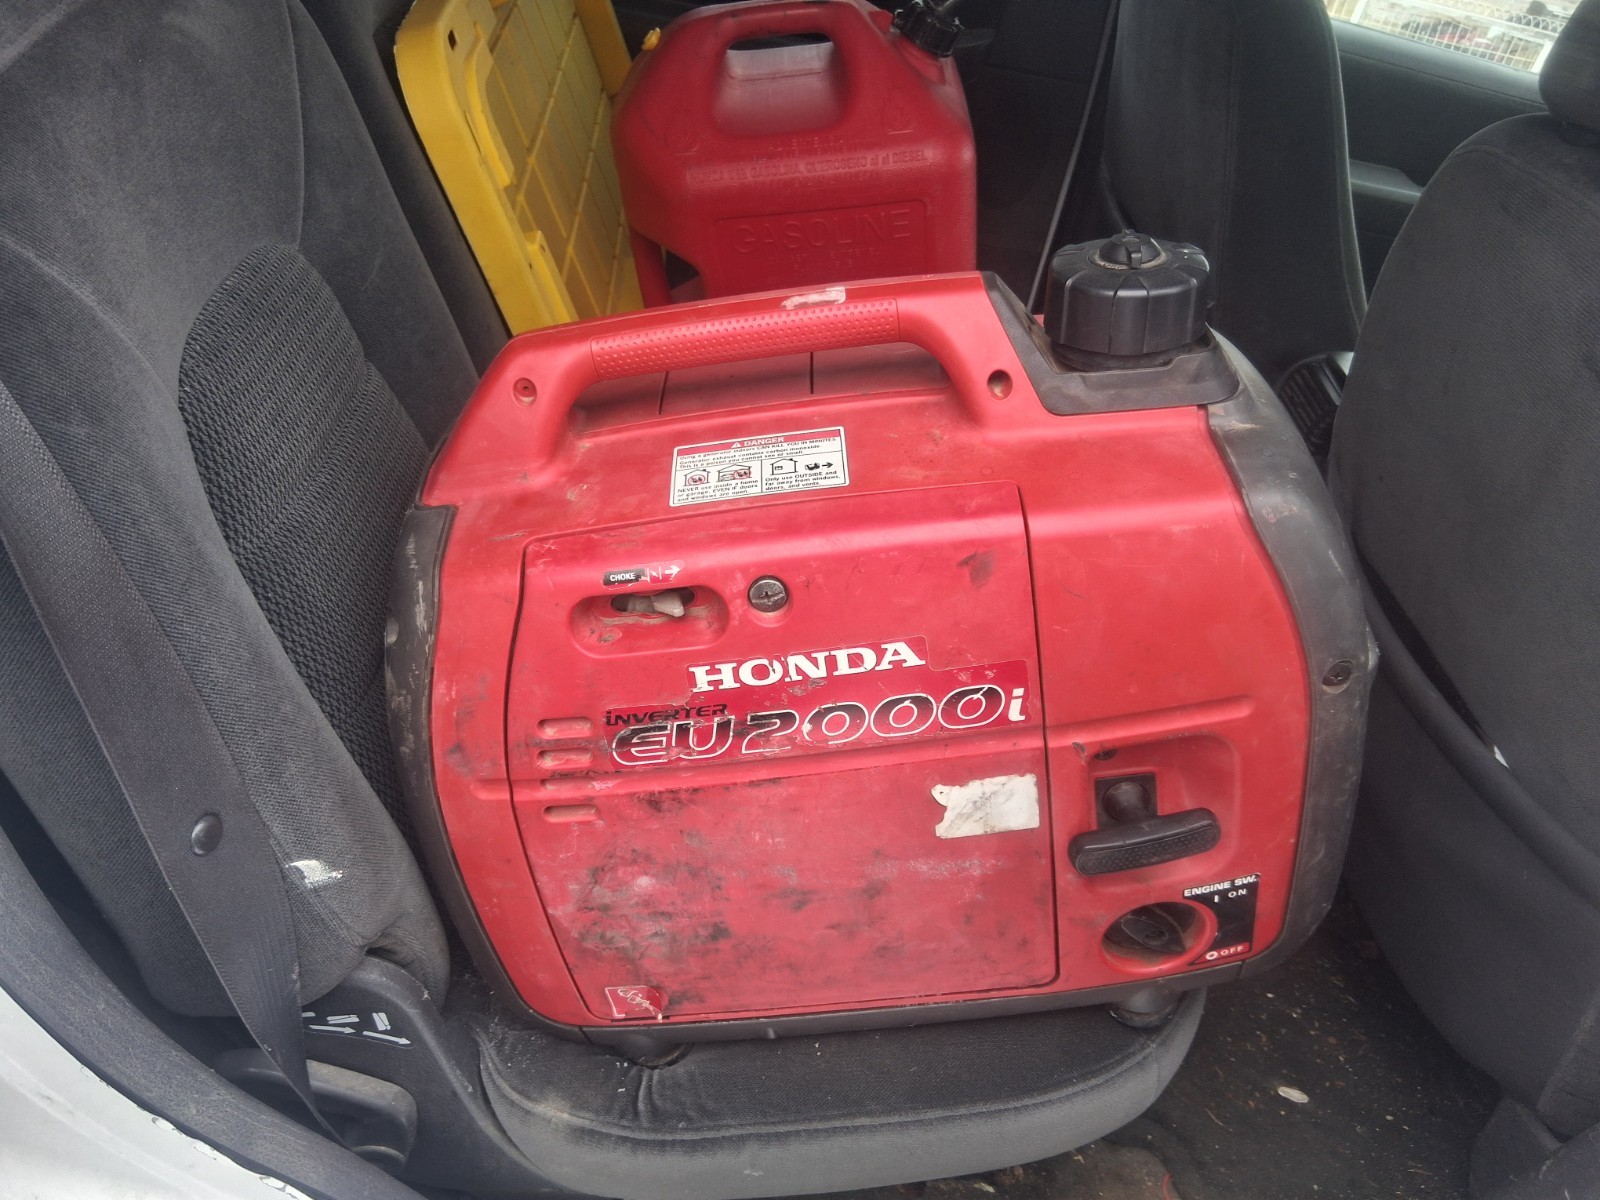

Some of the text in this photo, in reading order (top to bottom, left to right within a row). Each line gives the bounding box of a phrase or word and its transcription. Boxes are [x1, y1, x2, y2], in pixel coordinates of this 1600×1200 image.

[732, 209, 912, 253] GASOLINE
[743, 436, 785, 447] DANGER
[679, 457, 710, 466] Generator
[712, 454, 737, 462] exhaust
[764, 475, 780, 484] Only
[794, 470, 824, 480] OUTSIDE
[677, 486, 700, 494] NEVER
[713, 481, 733, 489] inside
[739, 478, 759, 486] home
[776, 479, 793, 487] away
[712, 486, 731, 494] EVEN
[690, 493, 717, 501] windows
[609, 572, 637, 582] CHOKE
[690, 640, 926, 693] HONDA
[611, 683, 1027, 766] EU2000i
[1183, 874, 1257, 897] ENGINE SW.
[1227, 888, 1247, 898] ON
[1220, 945, 1244, 956] OFF
